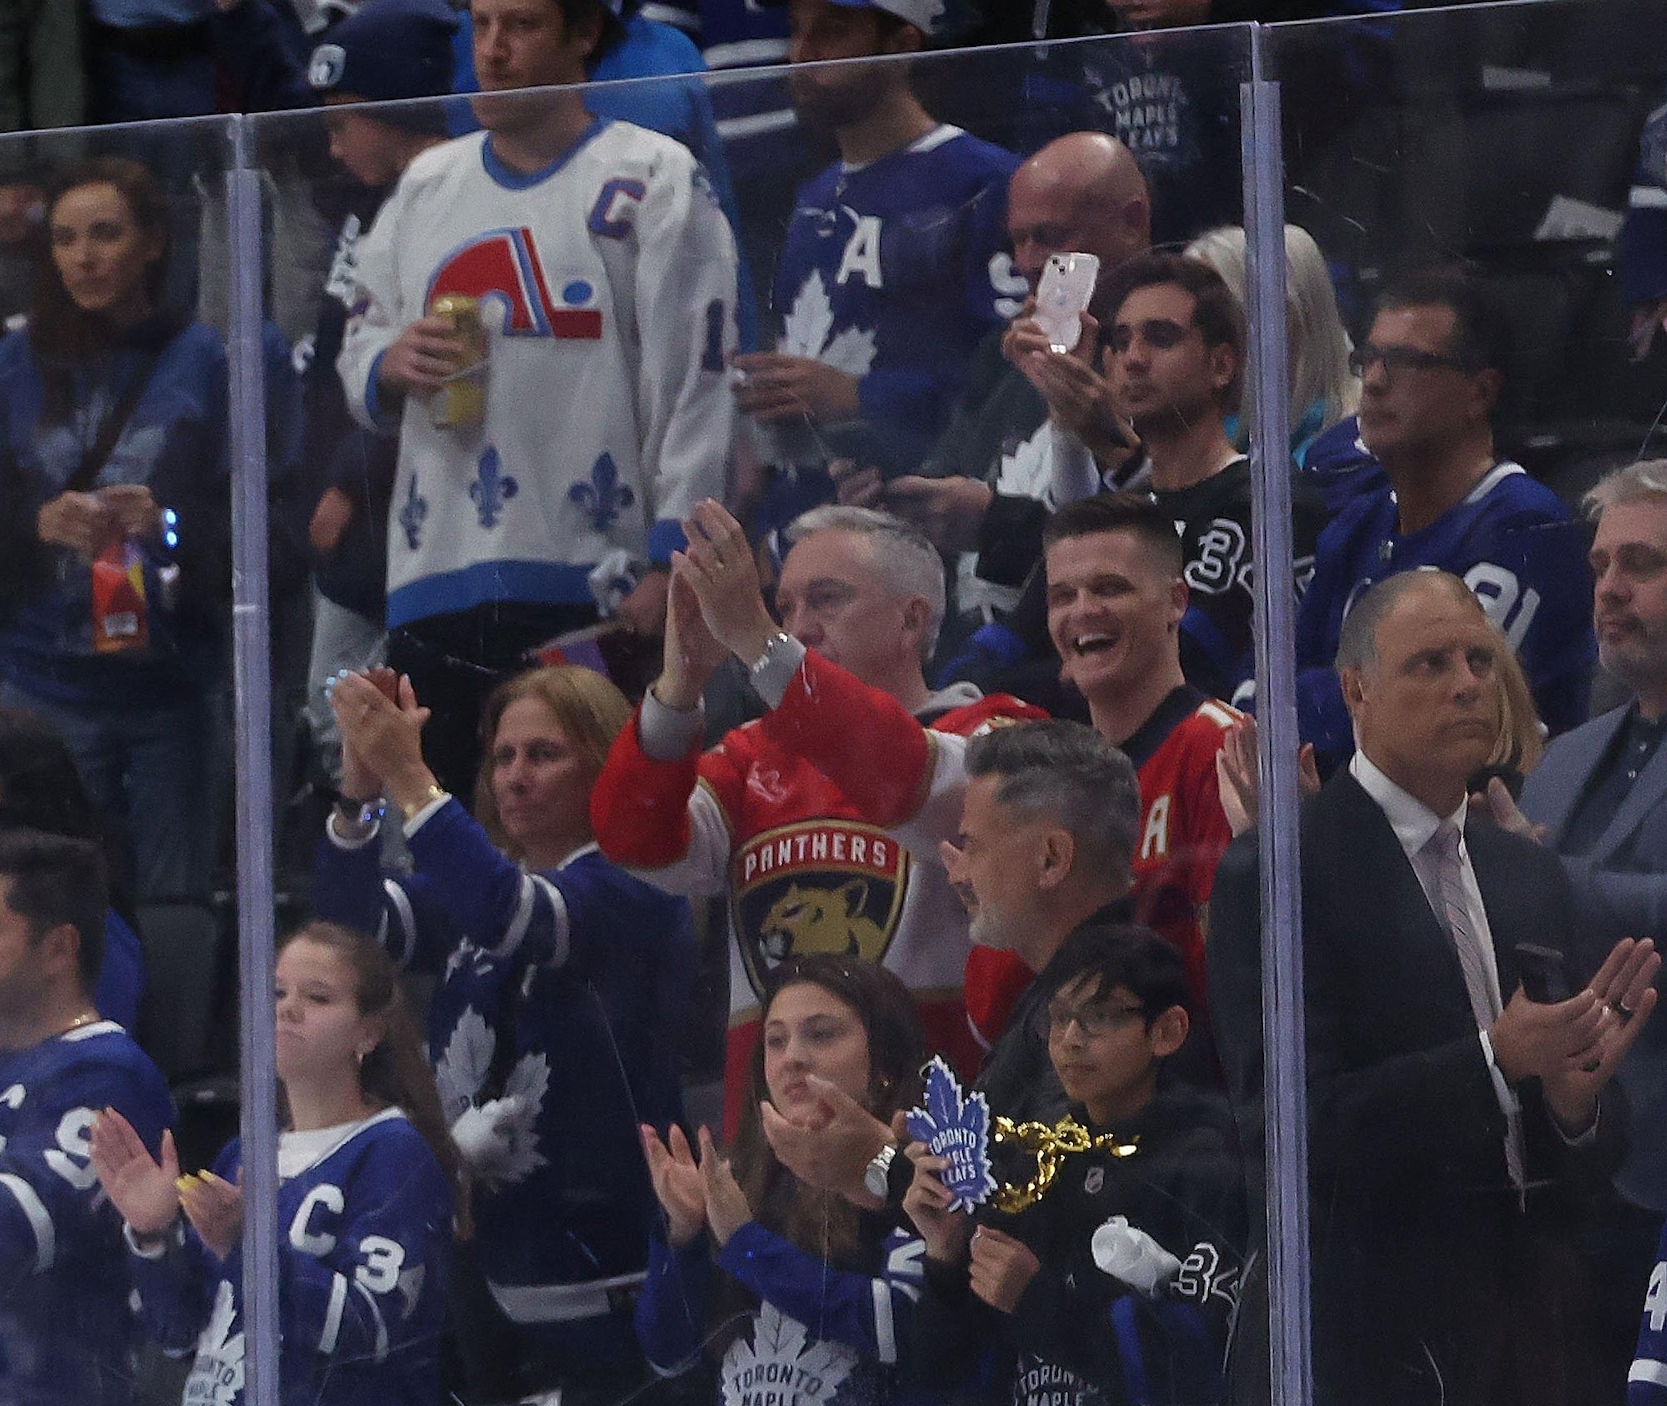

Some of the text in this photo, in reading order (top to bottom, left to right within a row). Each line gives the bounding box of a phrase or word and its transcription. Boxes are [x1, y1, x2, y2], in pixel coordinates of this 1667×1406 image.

[588, 178, 646, 240] C
[836, 215, 883, 289] A
[745, 832, 886, 881] PANTHERS
[1141, 793, 1171, 860] A
[43, 1106, 99, 1191] 9
[289, 1183, 344, 1257] C
[734, 1362, 824, 1396] TORONTO
